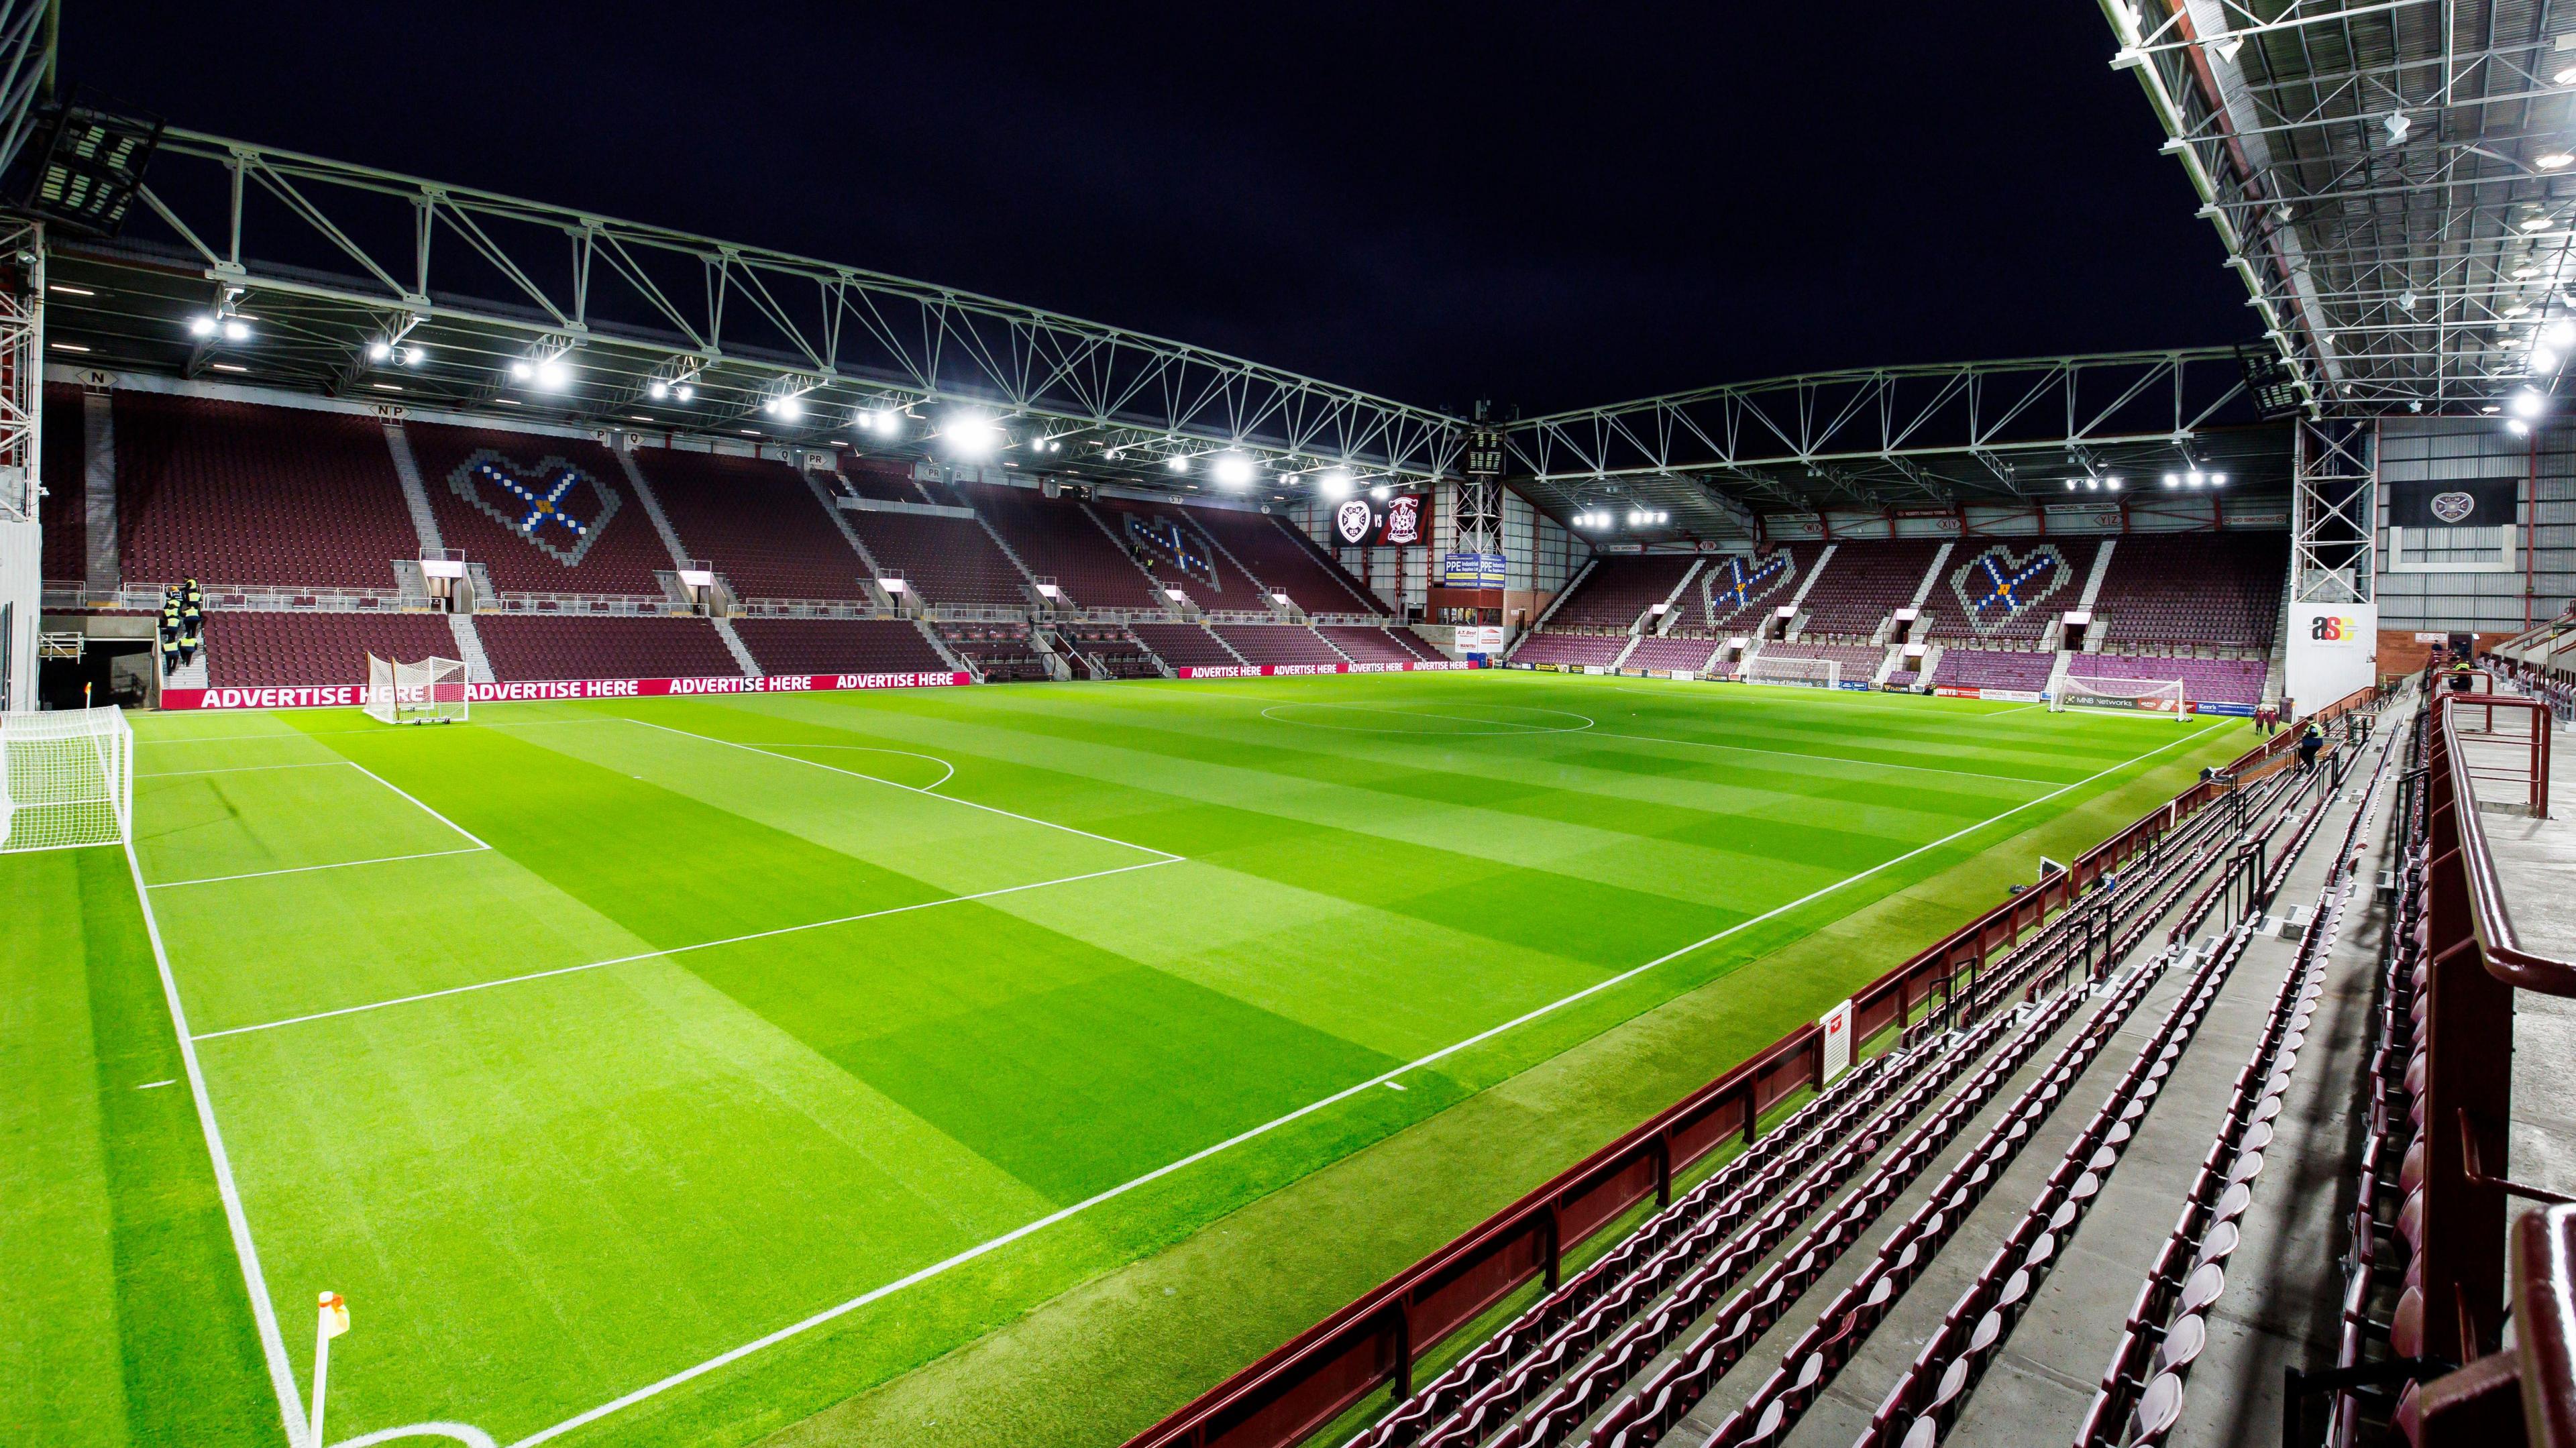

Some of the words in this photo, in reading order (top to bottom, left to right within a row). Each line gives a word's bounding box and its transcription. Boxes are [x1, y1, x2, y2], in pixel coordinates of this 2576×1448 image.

[92, 372, 105, 383] N
[378, 405, 388, 415] N
[394, 406, 402, 416] P
[597, 431, 604, 439] P
[631, 433, 638, 443] Q
[782, 451, 788, 460] Q
[809, 455, 822, 463] PR
[928, 469, 939, 477] PR
[1374, 514, 1382, 528] VS
[1951, 520, 1957, 528] Y
[1446, 561, 1462, 571] PPE
[1481, 561, 1493, 572] PPE
[2312, 616, 2355, 641] asc
[1273, 665, 1316, 675] ADVERTISE
[1317, 664, 1337, 674] HERE
[1348, 663, 1385, 673] ADVERTISE
[1385, 662, 1403, 671] HERE
[1413, 661, 1448, 671] ADVERTISE
[1449, 661, 1468, 669] HERE
[1191, 667, 1239, 678] ADVERTISE
[1240, 666, 1261, 676] HERE
[669, 677, 765, 694] ADVERTISE
[769, 676, 812, 691] HERE
[836, 673, 915, 689] ADVERTISE
[918, 672, 954, 685] HERE
[463, 681, 581, 700] ADVERTISE
[587, 680, 639, 696] HERE
[201, 686, 352, 708] ADVERTISE
[361, 684, 425, 704] HERE
[2096, 698, 2133, 706] Networks
